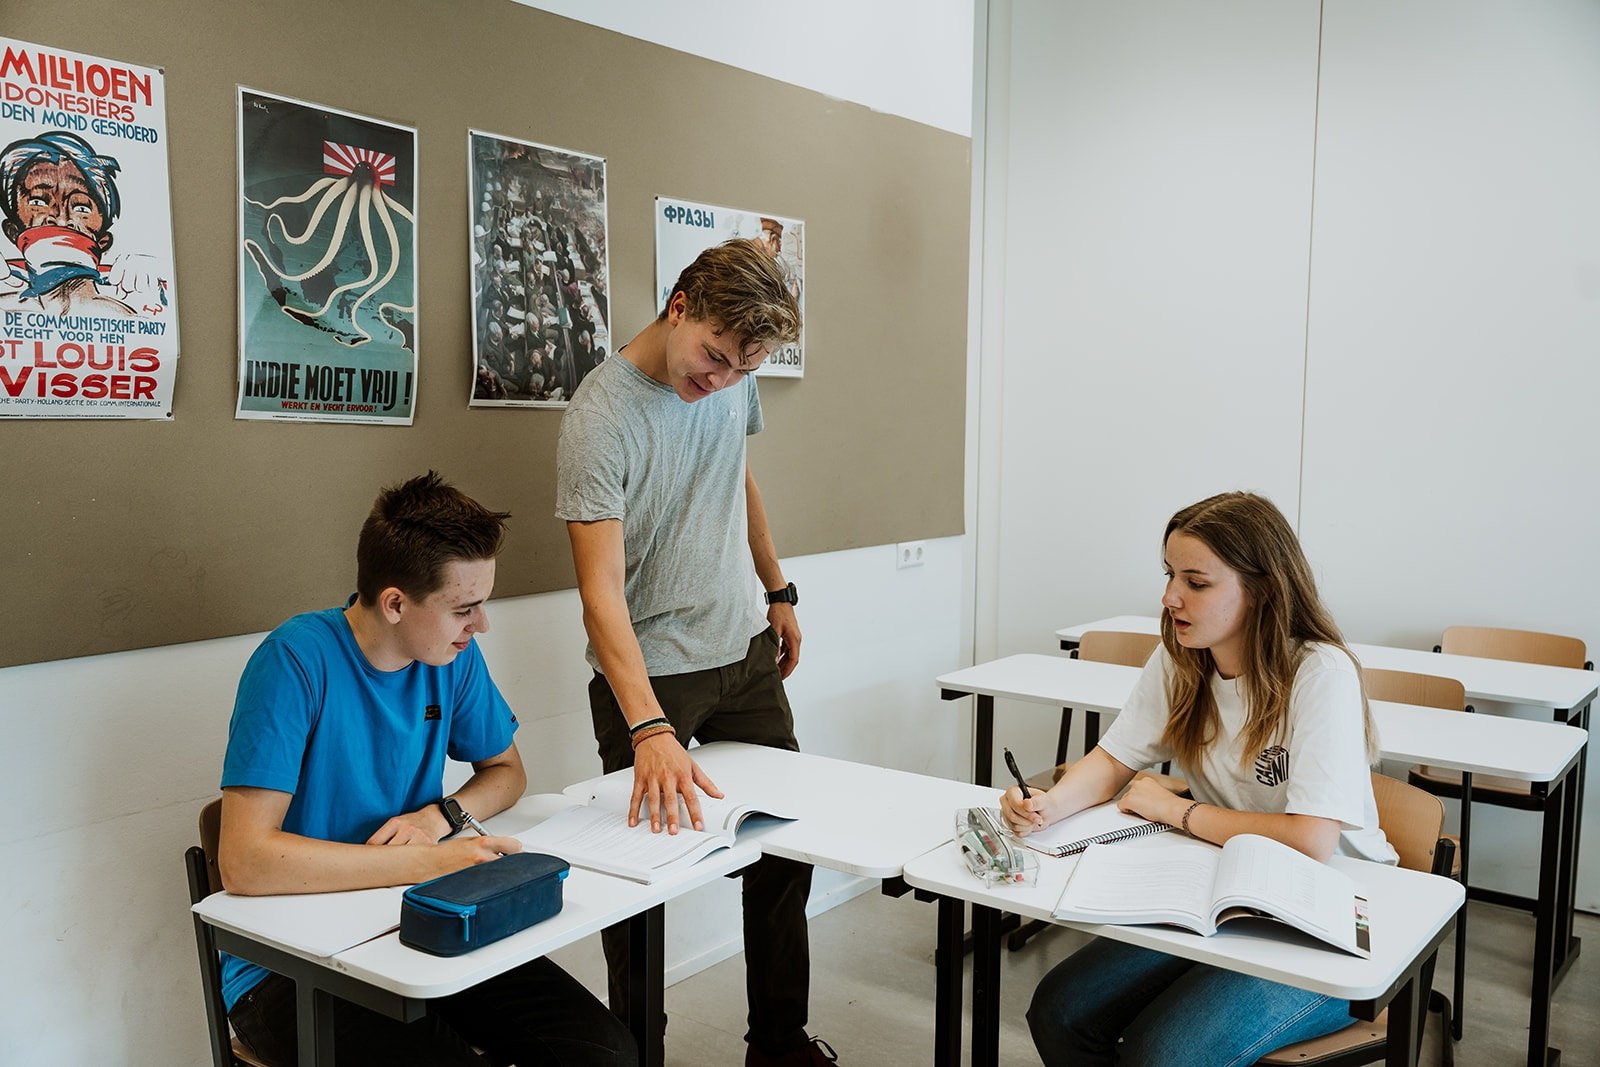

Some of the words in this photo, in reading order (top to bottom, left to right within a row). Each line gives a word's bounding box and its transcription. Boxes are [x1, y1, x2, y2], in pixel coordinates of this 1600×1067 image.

[0, 46, 152, 106] MILLIOEN
[0, 82, 135, 123] DONESIËRS
[2, 102, 35, 123] DEN
[42, 109, 88, 131] MOND
[91, 118, 158, 143] GESNOERD
[664, 205, 714, 229] ФРАЗЫ
[3, 327, 53, 340] VECHT
[58, 330, 94, 343] VOOR
[100, 333, 125, 344] HEN
[5, 312, 23, 327] DE
[27, 313, 136, 334] COMMUNISTISCHE
[138, 320, 166, 336] PARTY
[34, 341, 161, 373] LOUIS
[0, 366, 158, 400] VISSER
[245, 360, 300, 400] INDIE
[304, 364, 356, 402] MOET
[281, 400, 307, 410] WERKT
[310, 402, 321, 410] EN
[323, 403, 344, 412] VECHT
[346, 404, 378, 413] ERVOOR!
